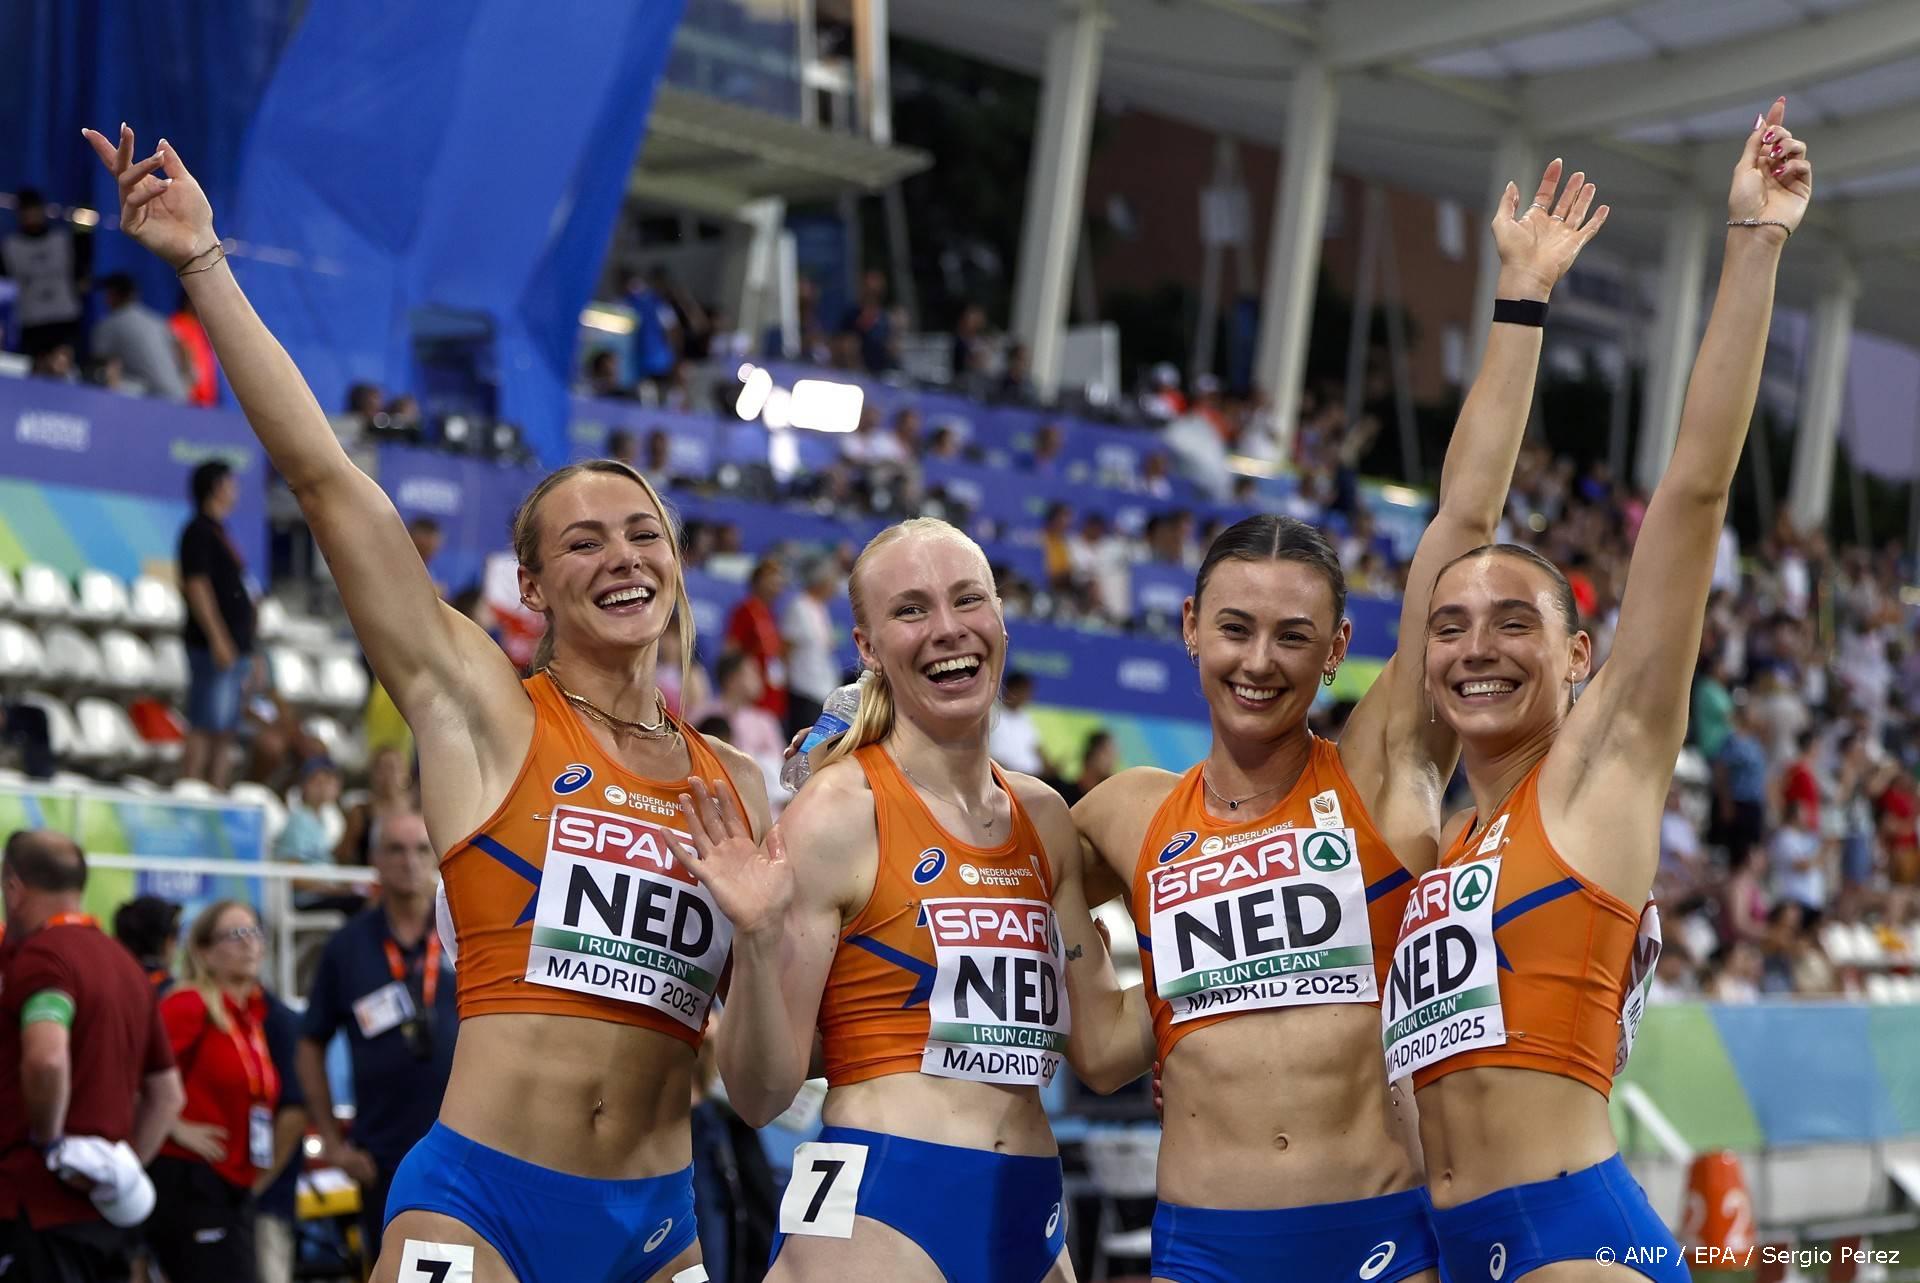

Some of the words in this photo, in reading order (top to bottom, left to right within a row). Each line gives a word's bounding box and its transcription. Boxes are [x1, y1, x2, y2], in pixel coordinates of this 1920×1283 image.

[628, 792, 687, 812] NEDERLAN
[628, 799, 675, 817] LOTERIJ
[1225, 820, 1294, 843] NEDERLANDSE
[981, 876, 1020, 887] LOTERIJ
[1157, 840, 1295, 906] SPAR
[563, 864, 714, 959] NED
[1399, 880, 1447, 930] PAR
[935, 908, 1048, 946] SPAR
[1174, 883, 1342, 972] NED
[578, 935, 586, 951] I
[588, 935, 631, 961] RUN
[546, 956, 657, 997] MADRID
[660, 982, 701, 1018] 2025
[953, 955, 1059, 1027] NED
[1208, 965, 1251, 986] RUN
[1389, 924, 1478, 1022] NED
[1187, 980, 1289, 1013] MADRID
[1295, 973, 1360, 996] 2025
[981, 1027, 1015, 1045] RUN
[1387, 1032, 1437, 1075] MADRID
[1440, 1015, 1485, 1050] 2025
[1397, 1013, 1418, 1038] RUN
[942, 1047, 1040, 1077] MADRID
[1040, 1056, 1060, 1080] 20
[803, 1160, 846, 1223] 7
